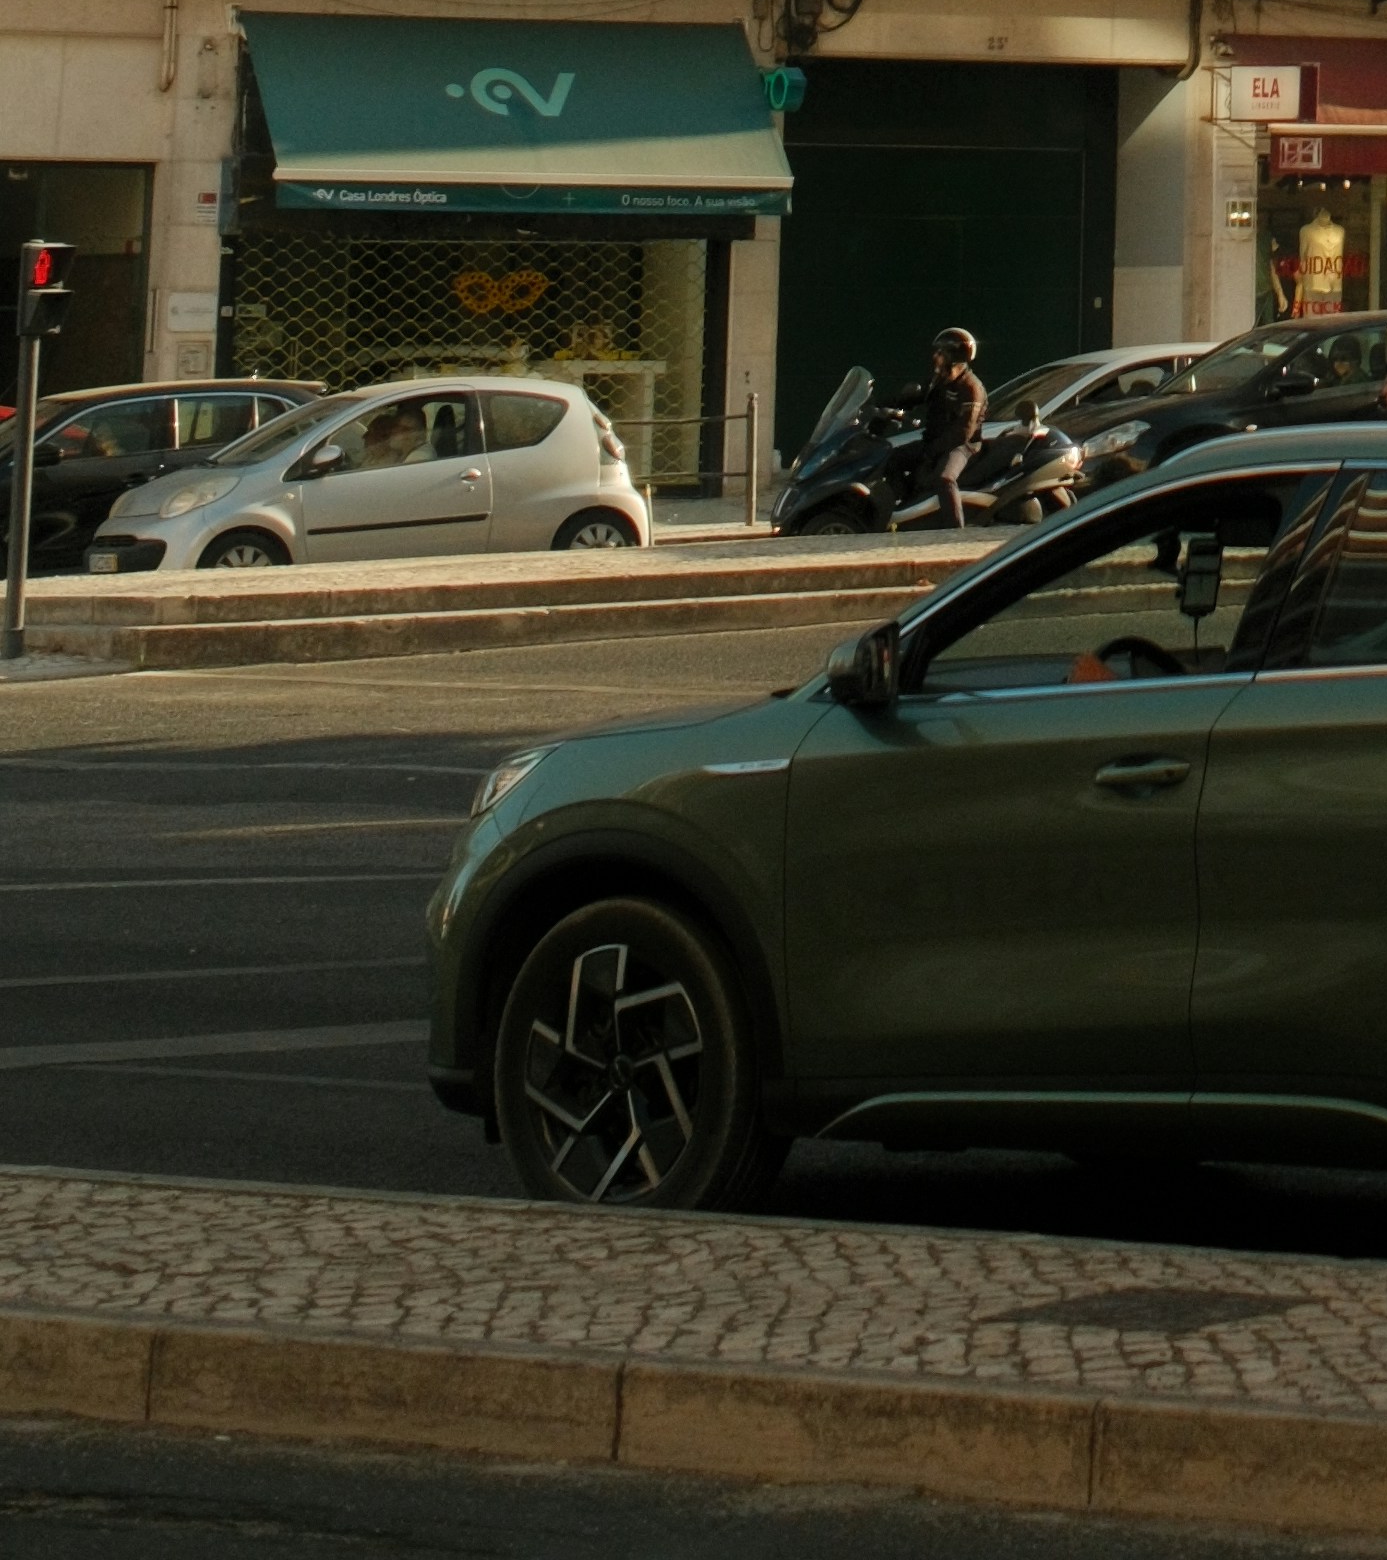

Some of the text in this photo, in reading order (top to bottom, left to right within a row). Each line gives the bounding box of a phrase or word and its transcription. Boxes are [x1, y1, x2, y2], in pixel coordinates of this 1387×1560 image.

[1252, 77, 1280, 98] ELA
[339, 189, 366, 202] Casa
[367, 189, 411, 203] Londres
[621, 193, 631, 206] O
[632, 196, 665, 207] nosso
[693, 195, 703, 207] A
